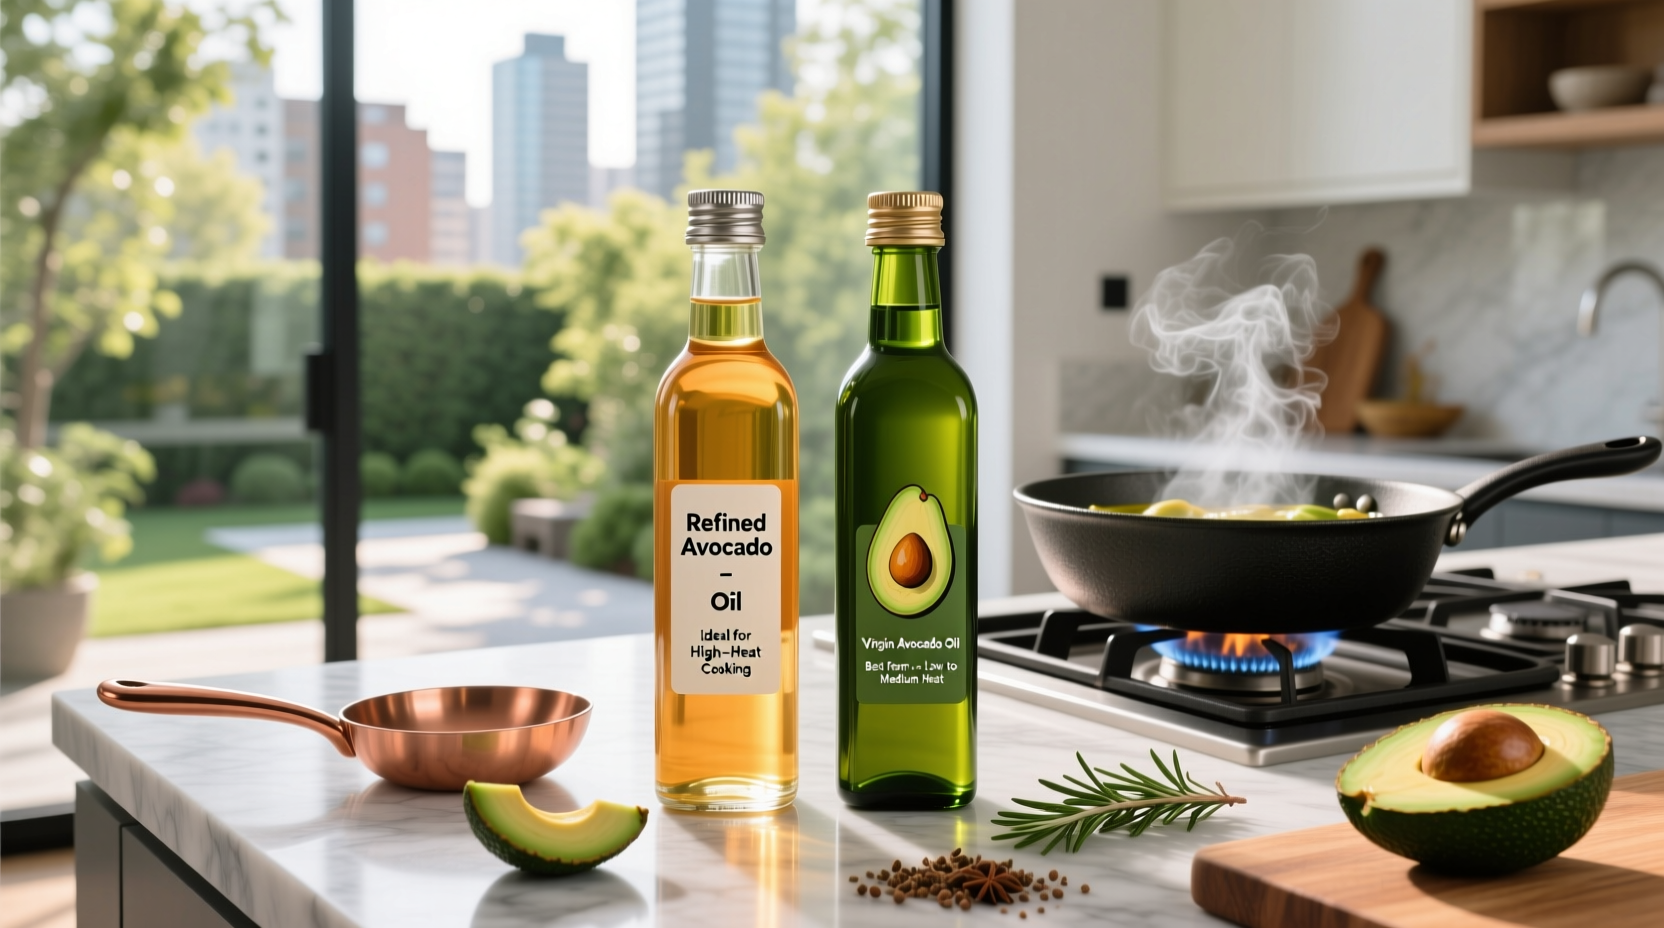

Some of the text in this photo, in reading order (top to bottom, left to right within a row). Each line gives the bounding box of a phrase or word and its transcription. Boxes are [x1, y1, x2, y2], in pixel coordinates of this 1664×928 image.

[687, 513, 766, 532] Refined
[681, 537, 772, 556] Avocado
[711, 591, 741, 611] Oil
[701, 629, 751, 641] Ideal for
[897, 637, 942, 649] Avocado
[701, 663, 751, 677] Cooking
[947, 662, 957, 671] to
[922, 674, 944, 684] Heat
